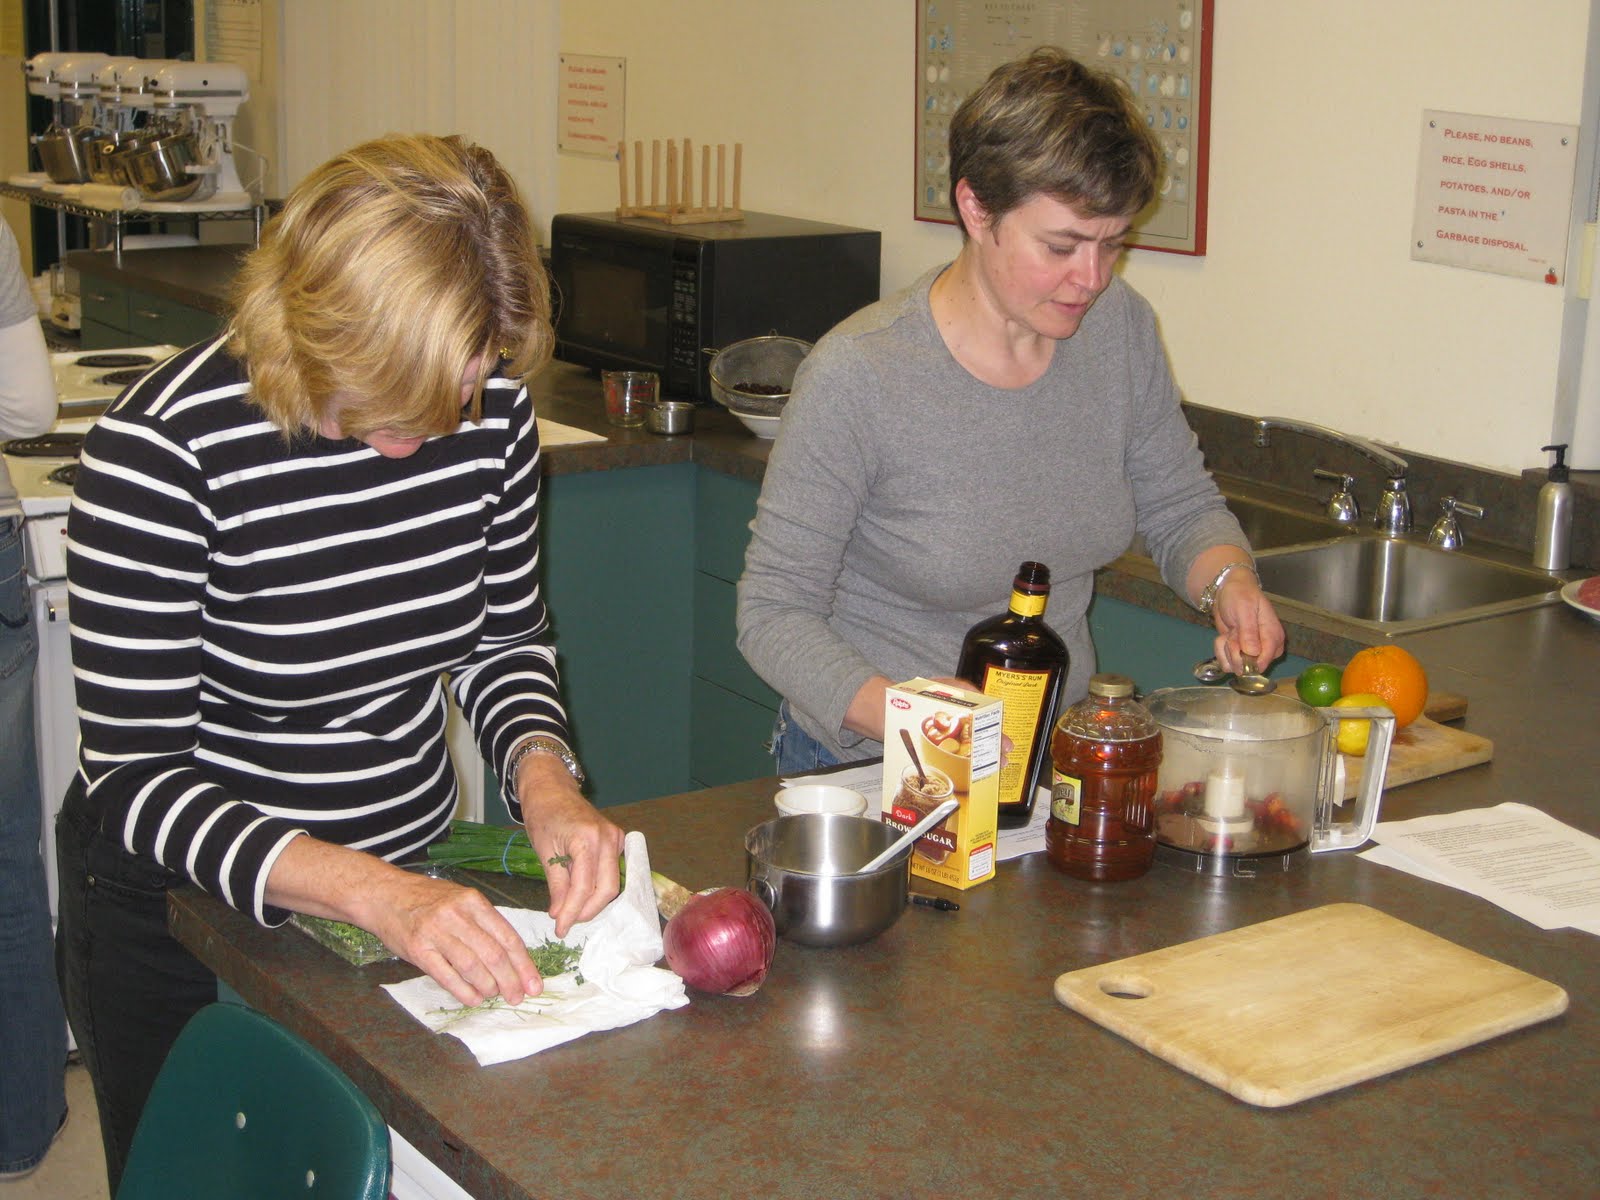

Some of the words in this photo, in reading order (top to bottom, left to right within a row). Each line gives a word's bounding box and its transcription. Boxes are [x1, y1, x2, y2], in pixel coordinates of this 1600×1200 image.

[1444, 128, 1481, 142] PLEASE,
[1484, 134, 1498, 143] NO
[1500, 136, 1533, 148] BEANS,
[1468, 157, 1487, 168] EGG
[1489, 160, 1526, 173] SHELLS,
[1491, 187, 1531, 199] AND/OR
[1438, 205, 1467, 217] PASTA
[1469, 209, 1478, 218] IN
[1480, 211, 1498, 221] THE
[1436, 229, 1480, 244] GARBAGE
[1482, 237, 1528, 252] DISPOSAL.
[895, 809, 913, 821] Dark
[885, 817, 912, 834] BROW
